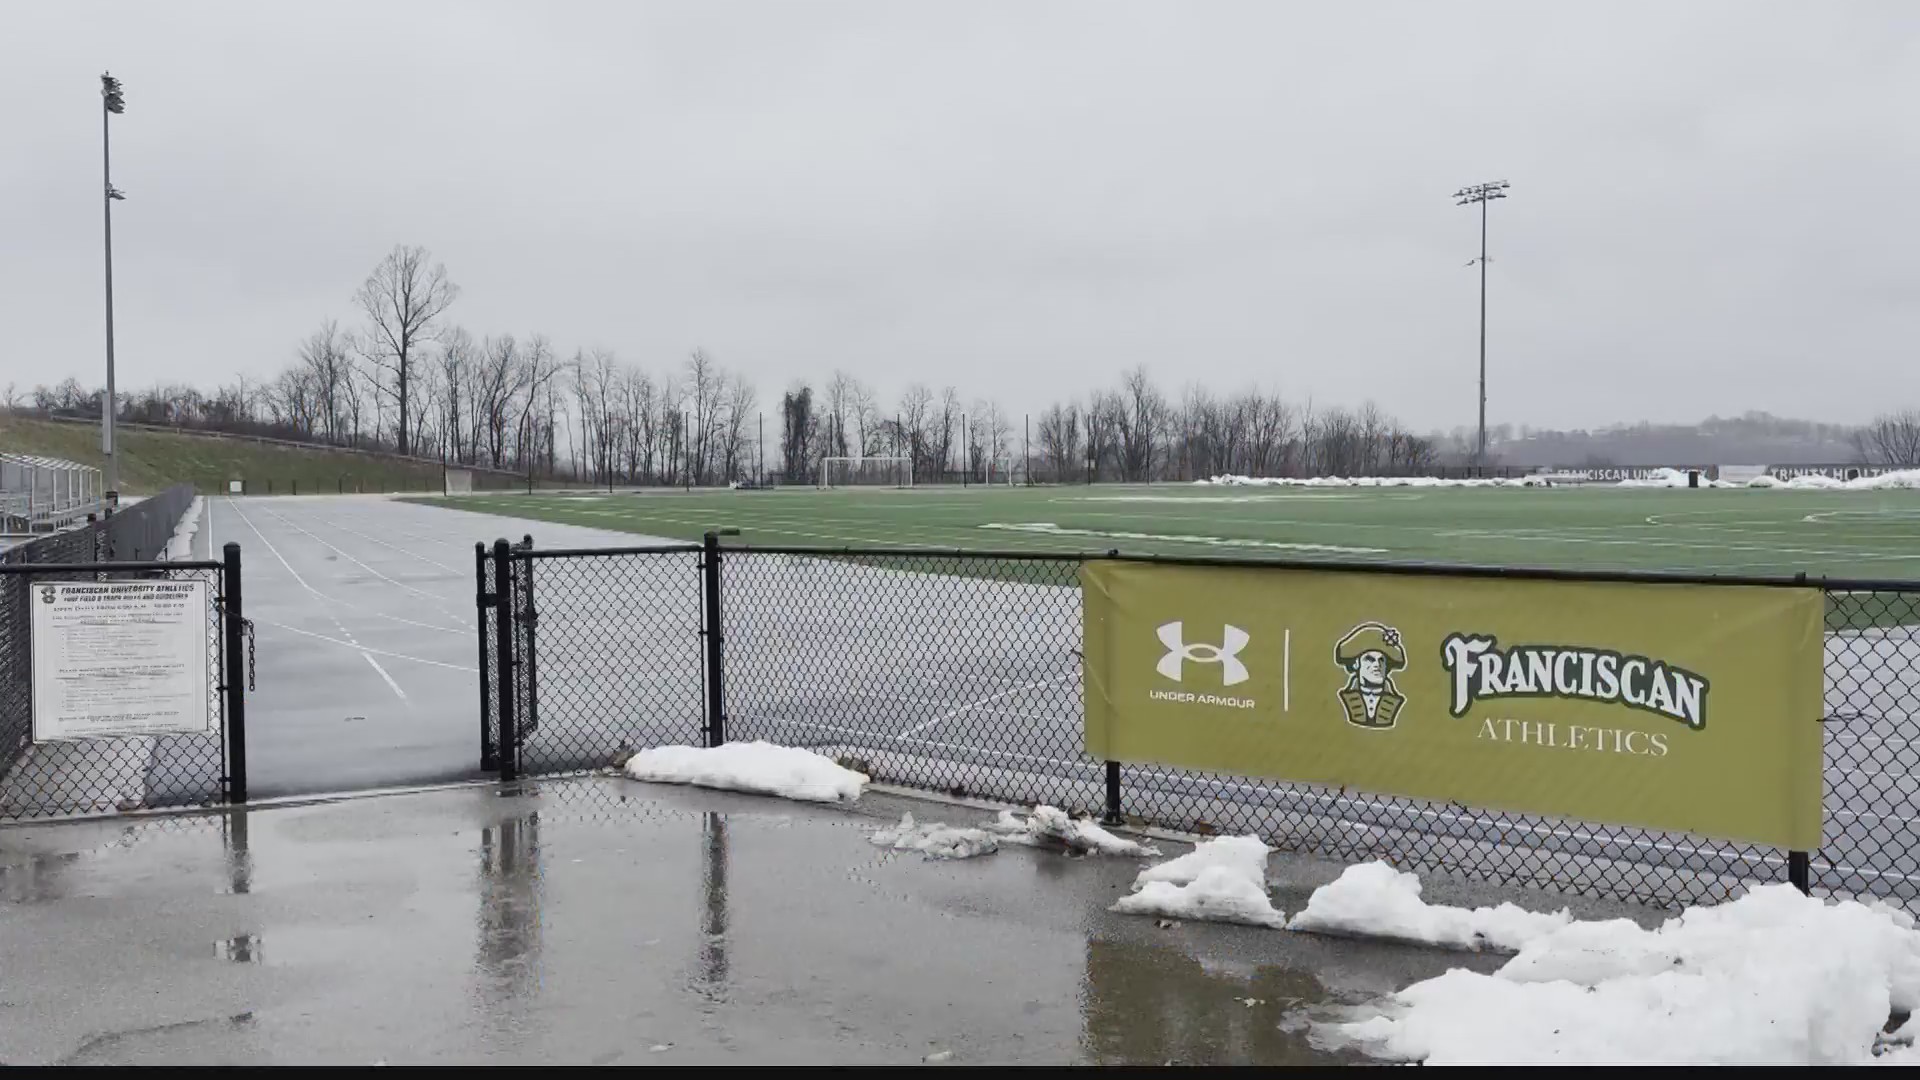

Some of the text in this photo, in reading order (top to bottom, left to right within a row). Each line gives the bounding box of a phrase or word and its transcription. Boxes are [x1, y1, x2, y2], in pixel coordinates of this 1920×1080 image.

[1149, 690, 1256, 709] UNDER ARMOUR
[1443, 635, 1707, 728] FRANCISCAN
[1476, 717, 1669, 757] ATHLETICS
